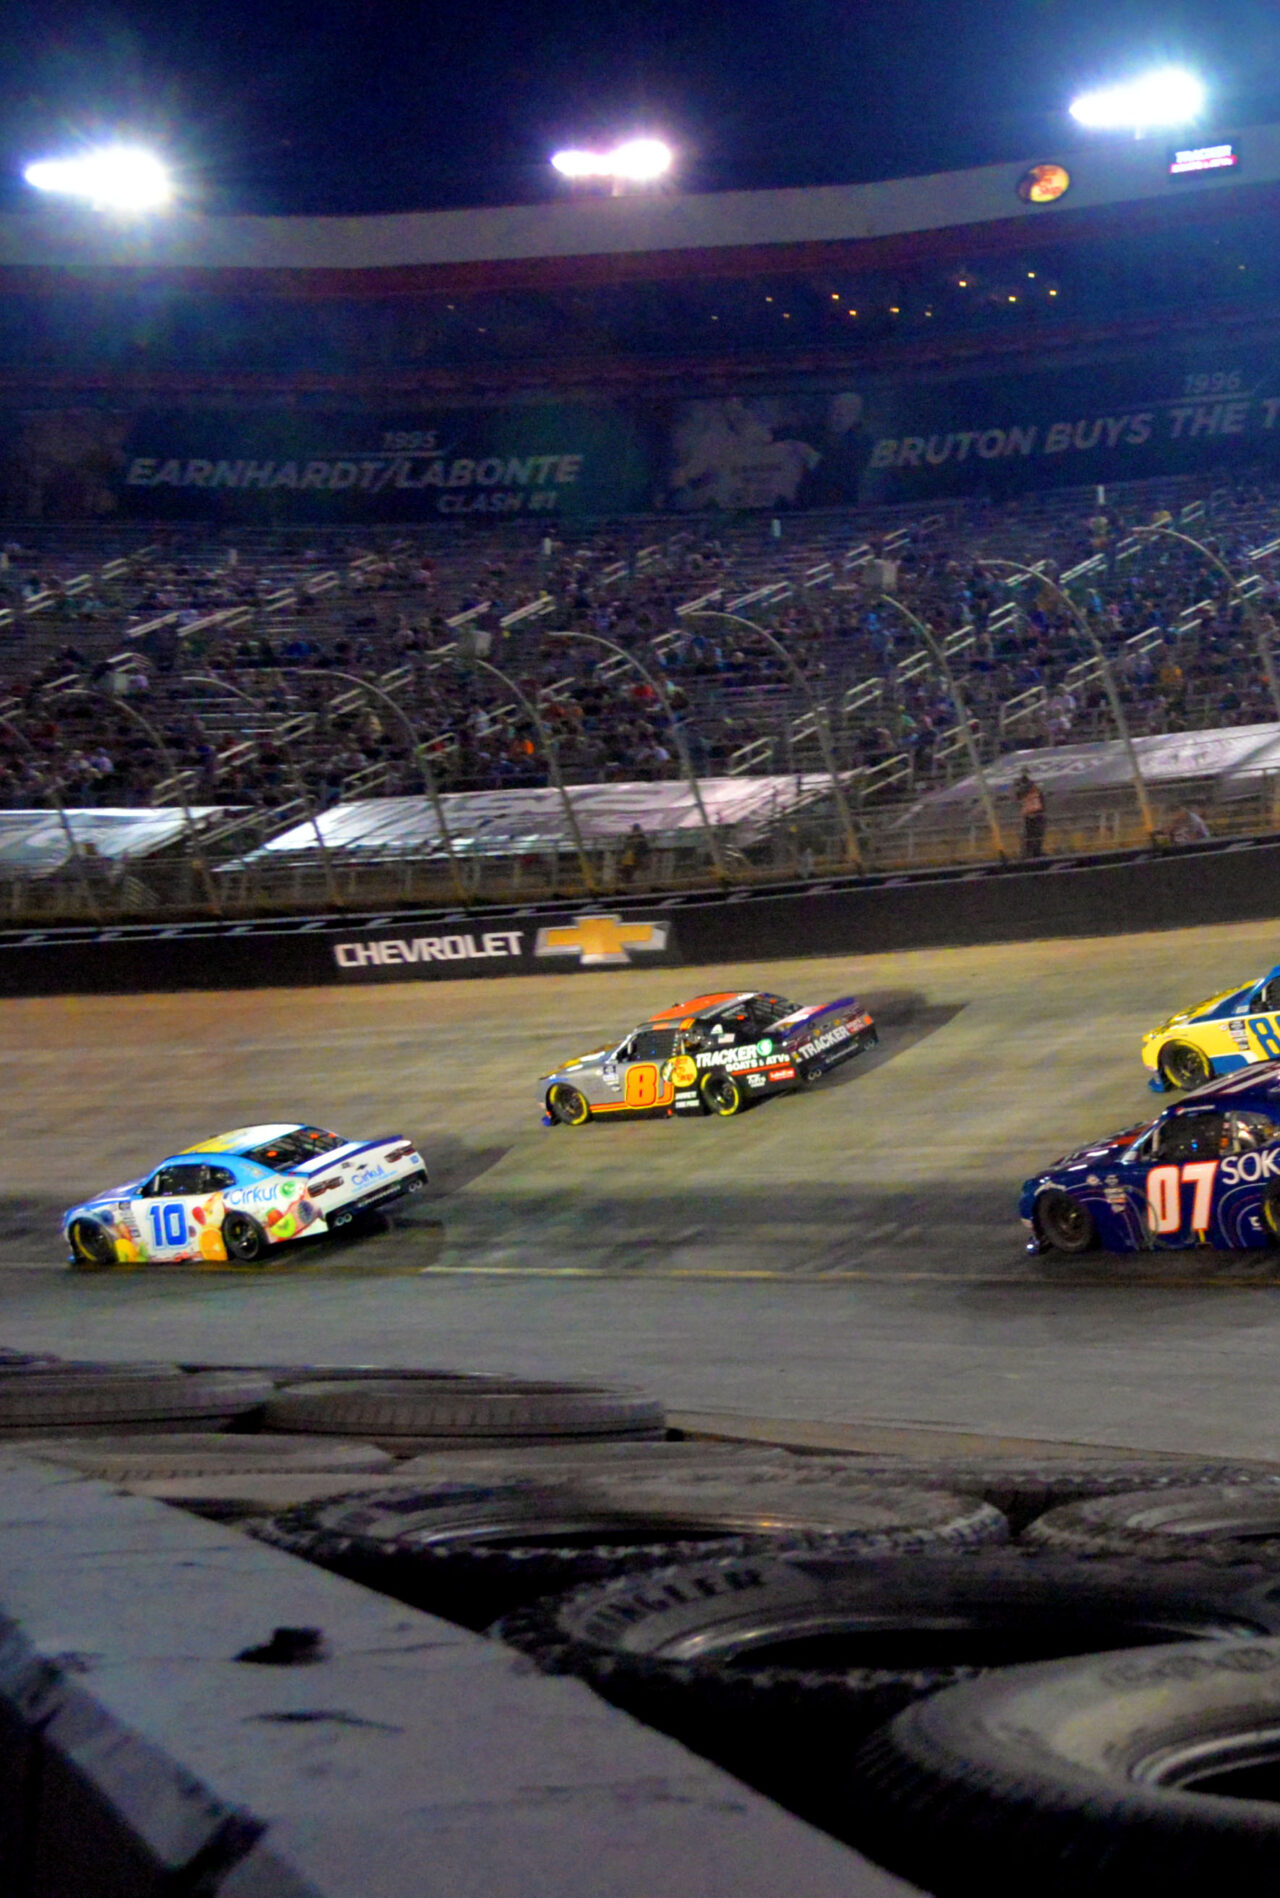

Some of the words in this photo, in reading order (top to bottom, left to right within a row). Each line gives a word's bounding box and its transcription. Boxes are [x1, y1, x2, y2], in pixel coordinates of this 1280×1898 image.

[869, 425, 1038, 467] BRUTON
[1044, 413, 1155, 454] BUYS
[1169, 401, 1251, 439] THE
[127, 454, 583, 491] EARNHARDT/LABONTE
[334, 931, 524, 967] CHEVROLET
[696, 1044, 758, 1068] TRACKER
[798, 1025, 850, 1059] TRACKER
[624, 1062, 659, 1108] 8
[351, 1165, 385, 1186] Cirkul
[229, 1183, 278, 1206] Cirkul
[1147, 1160, 1219, 1234] 07
[148, 1202, 188, 1249] 10
